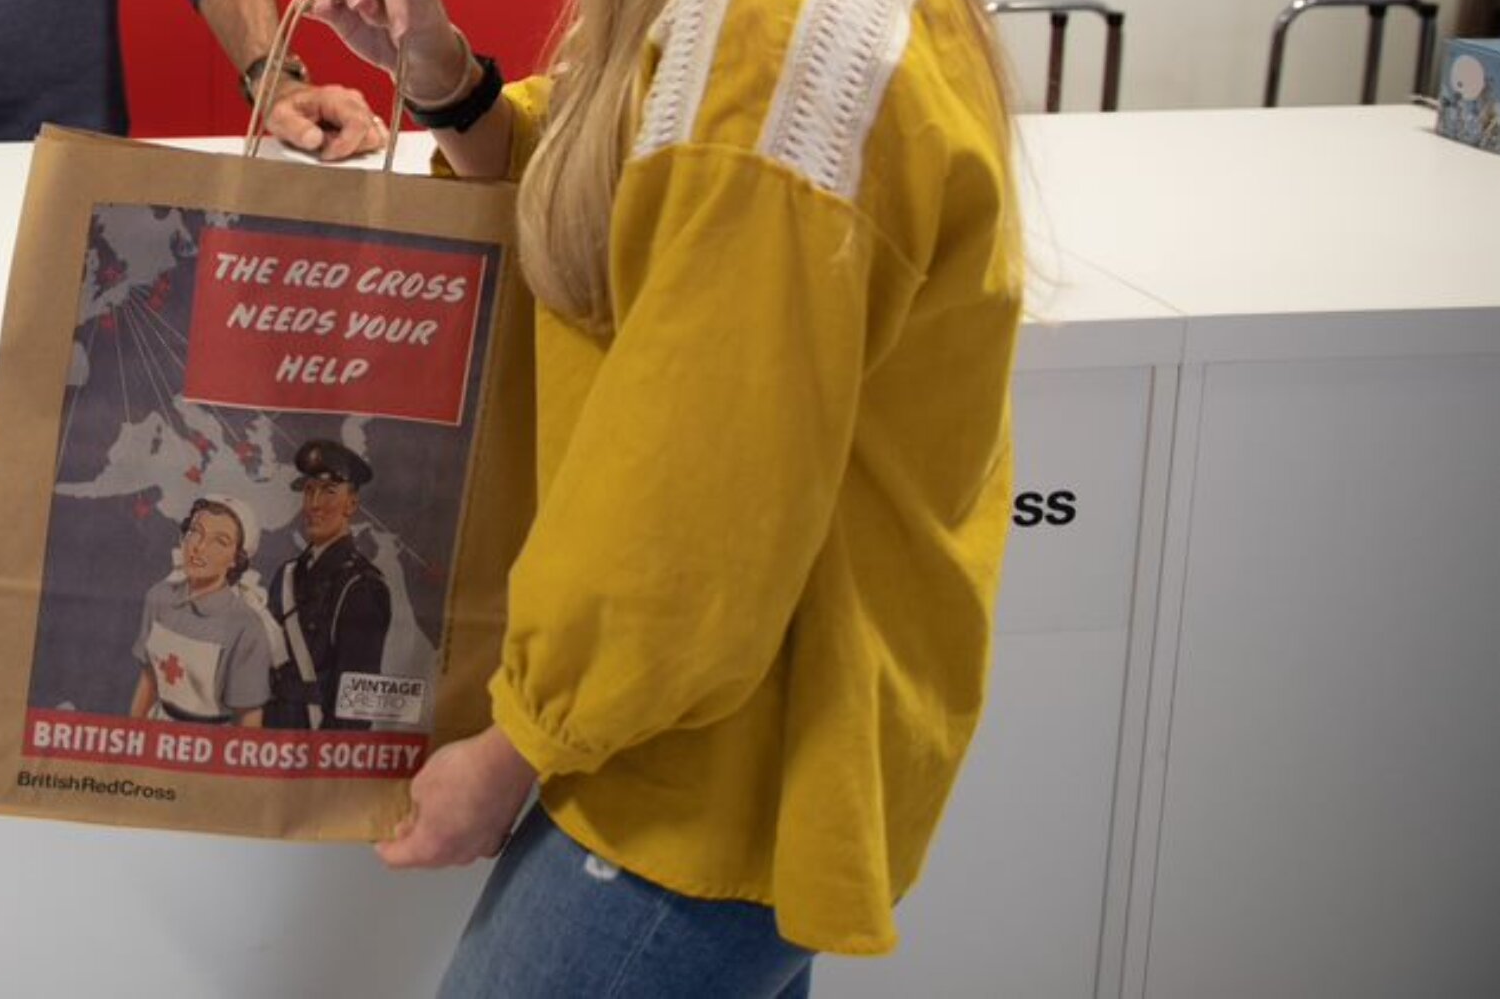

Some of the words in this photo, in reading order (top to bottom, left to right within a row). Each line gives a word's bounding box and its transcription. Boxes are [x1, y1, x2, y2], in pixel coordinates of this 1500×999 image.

[214, 253, 279, 284] THE
[283, 259, 350, 289] RED
[356, 267, 467, 303] CROSS
[226, 303, 336, 335] NEEDS
[344, 311, 438, 345] YOUR
[276, 355, 369, 384] HELP
[349, 678, 422, 697] VINTAGE
[32, 721, 145, 756] BRITISH
[156, 733, 213, 764] RED
[223, 738, 308, 769] CROSS
[318, 742, 421, 771] SOCIETY
[16, 770, 177, 802] BritishRedCross
